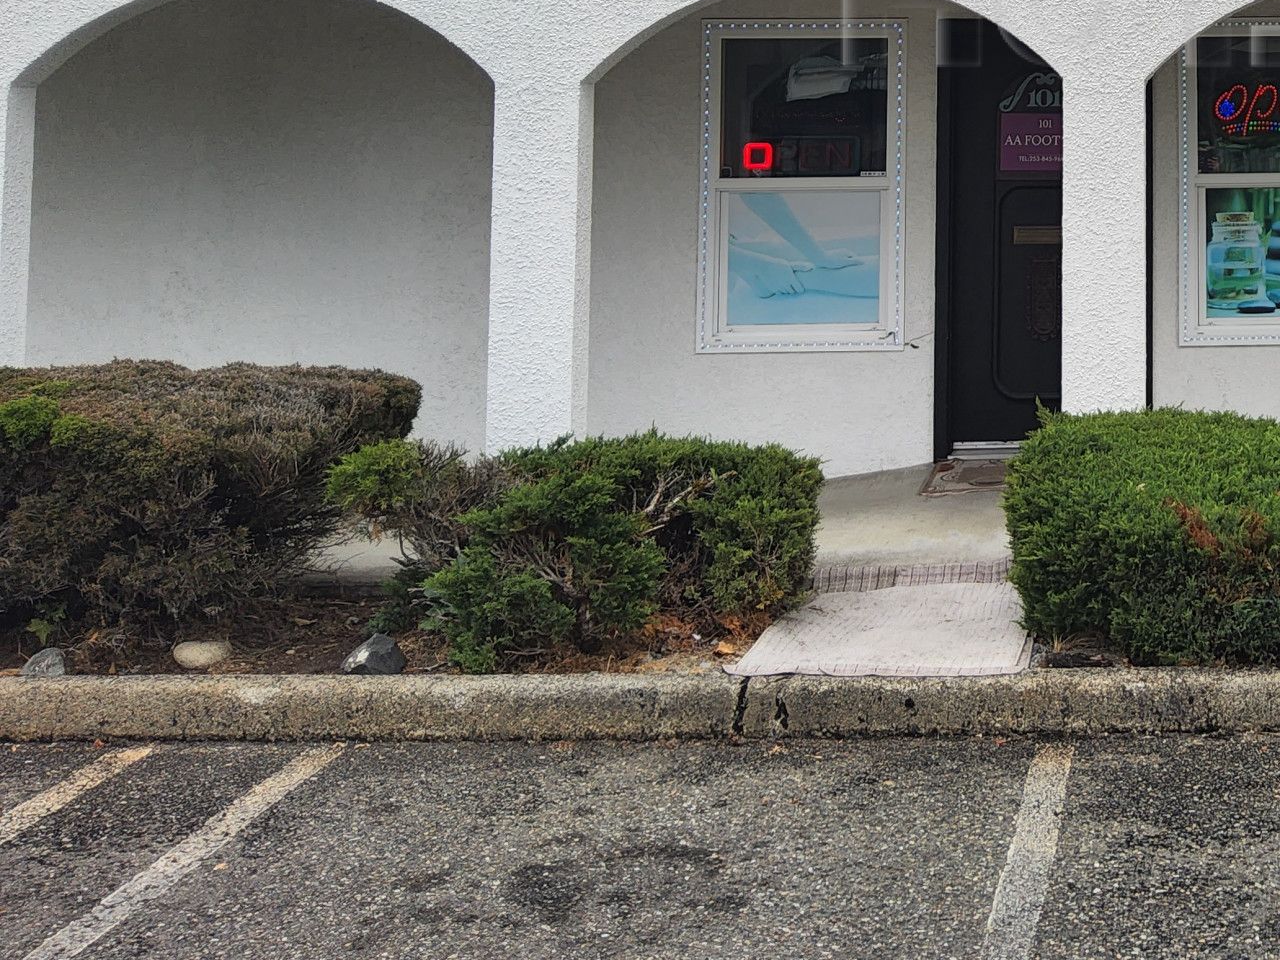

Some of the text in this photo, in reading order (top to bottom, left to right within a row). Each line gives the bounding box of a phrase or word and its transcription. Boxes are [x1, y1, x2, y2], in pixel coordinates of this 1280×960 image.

[1026, 88, 1061, 107] 101
[1038, 119, 1053, 129] 101
[1004, 134, 1061, 146] AA FOOT
